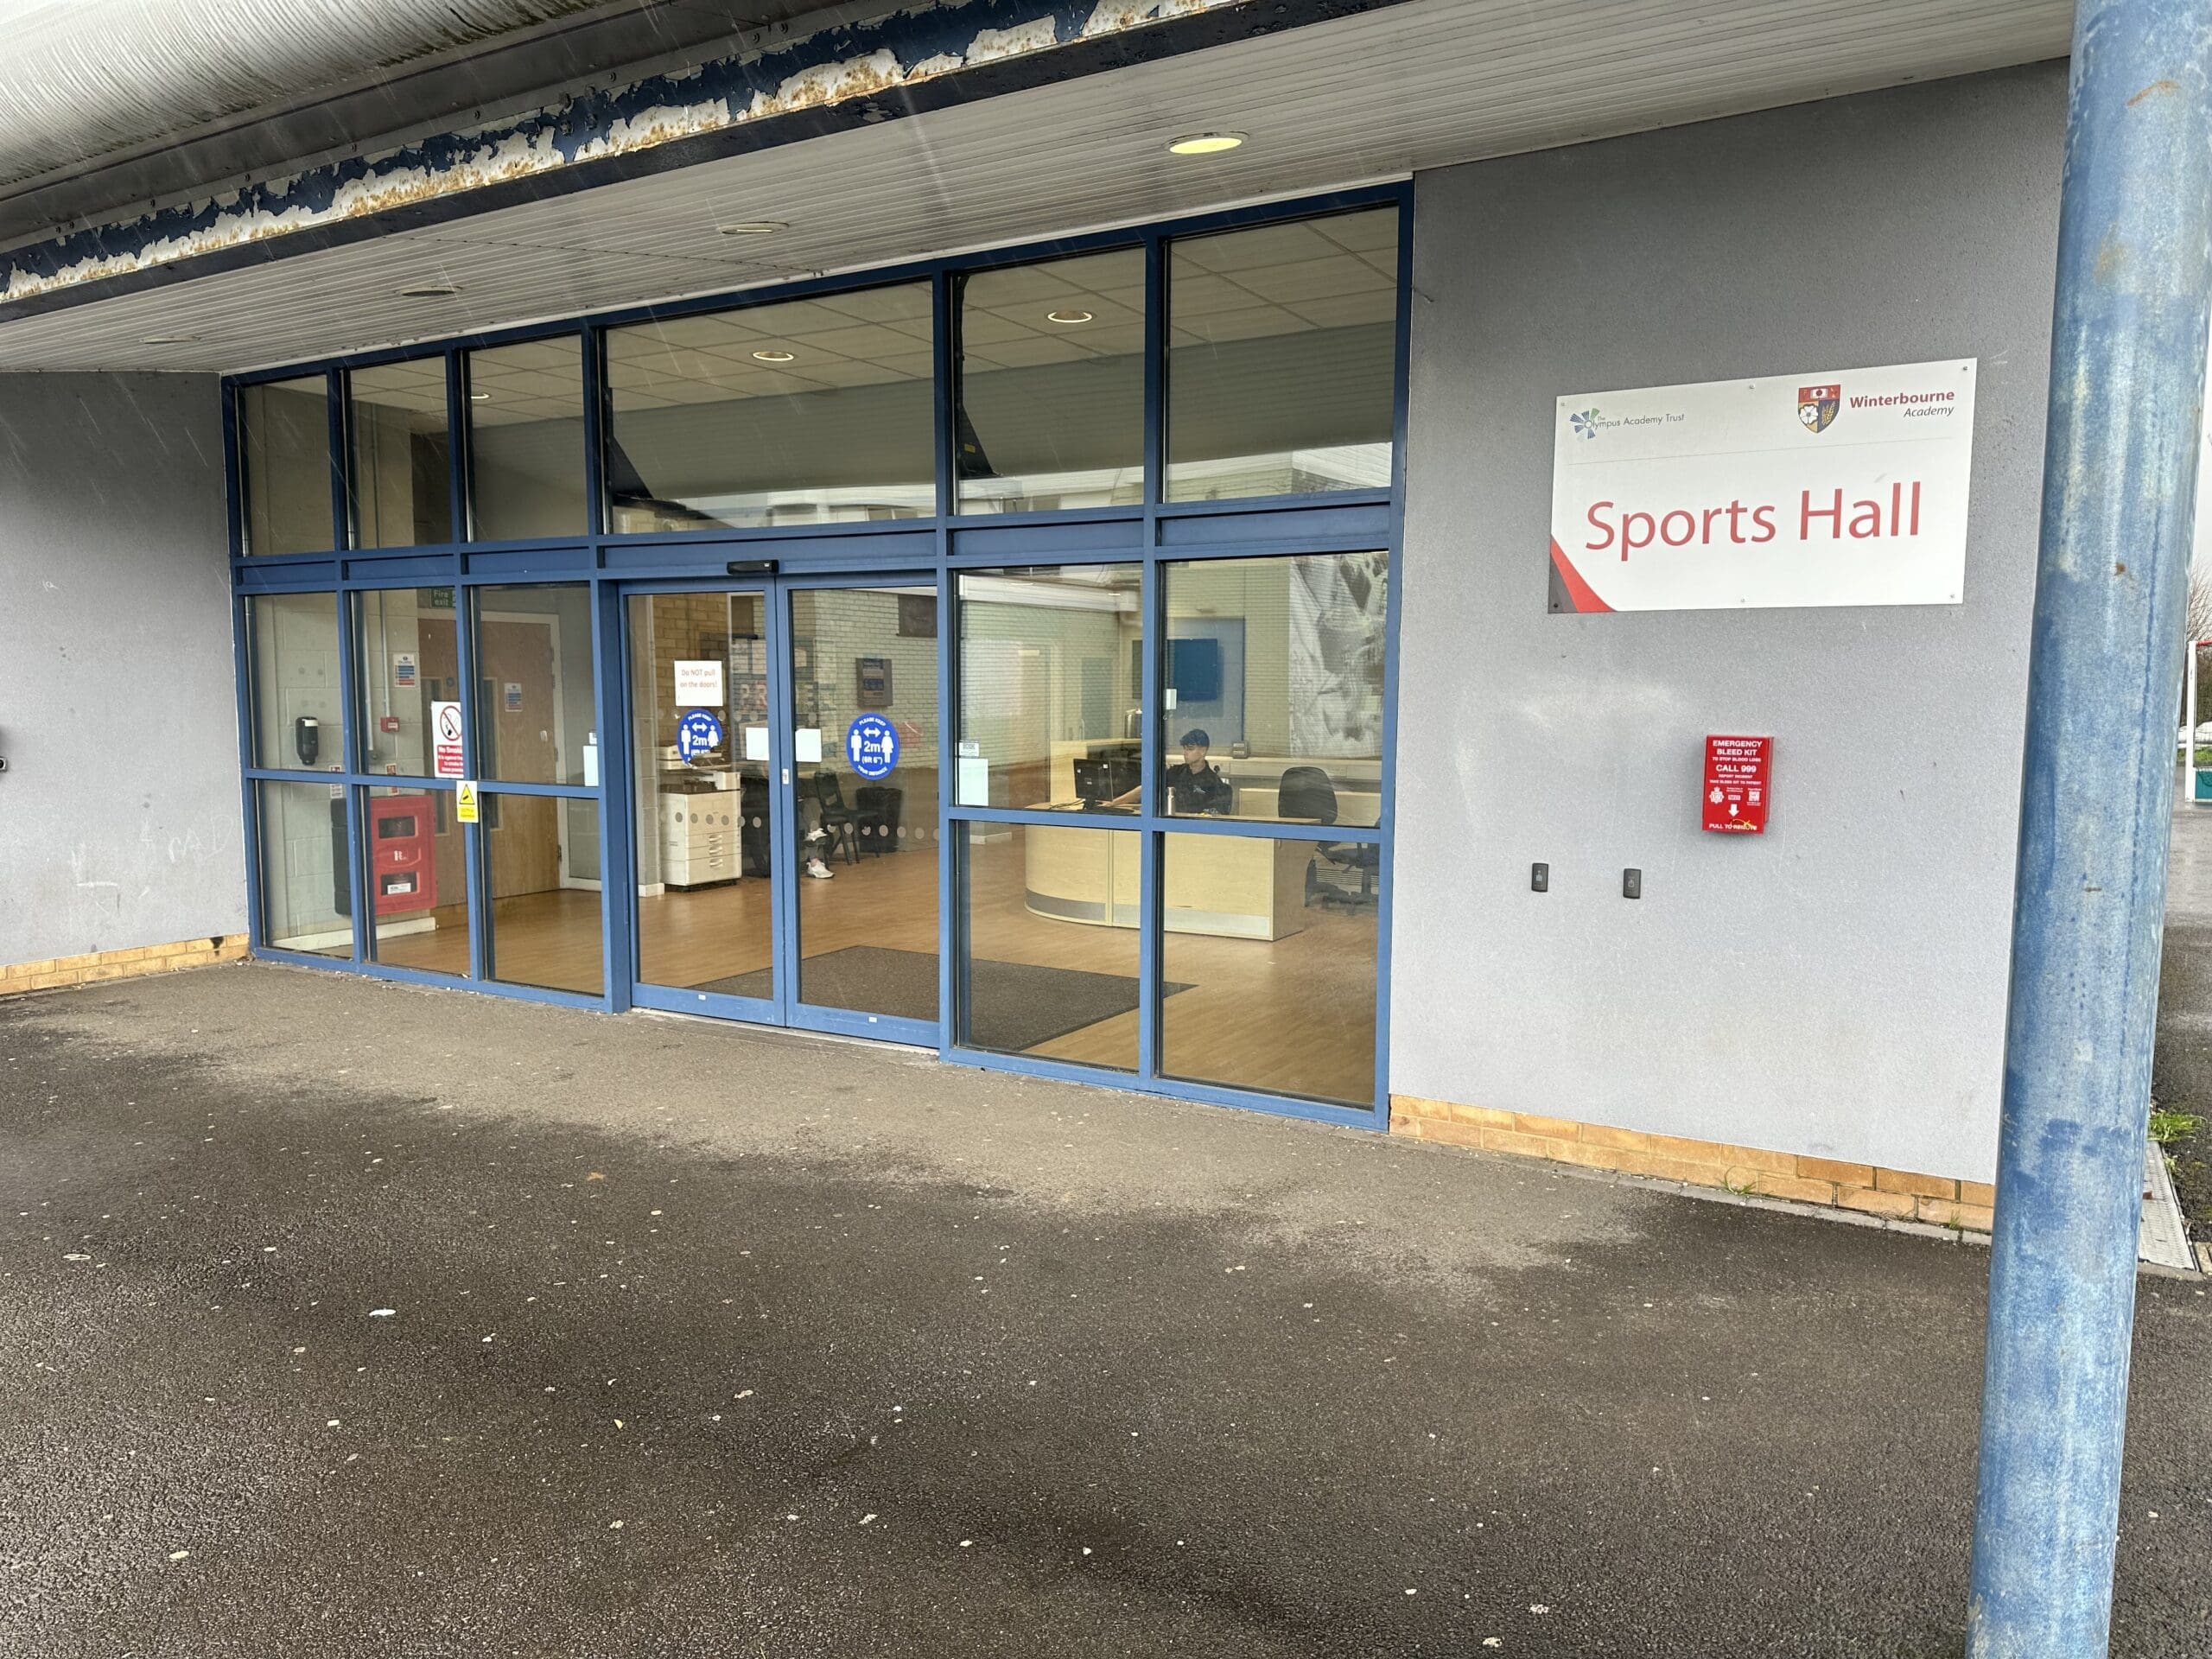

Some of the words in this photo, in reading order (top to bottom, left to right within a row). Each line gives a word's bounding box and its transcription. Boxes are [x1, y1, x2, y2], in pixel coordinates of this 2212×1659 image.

[1850, 391, 1955, 409] Winterbourne
[1903, 406, 1955, 417] Academy
[1584, 419, 1620, 430] Olympus
[1624, 416, 1662, 426] Academy
[1665, 413, 1685, 423] Trust
[1586, 499, 1777, 562] Sports
[1799, 481, 1921, 541] Hall
[434, 588, 448, 598] Fire
[704, 669, 715, 677] pull
[699, 679, 718, 688] doors!
[858, 716, 874, 726] PLEASE
[874, 717, 887, 727] KEEP
[692, 734, 708, 747] 2m
[1712, 740, 1763, 748] EMERGENCY
[863, 740, 881, 753] 2m
[1715, 764, 1738, 772] CALL
